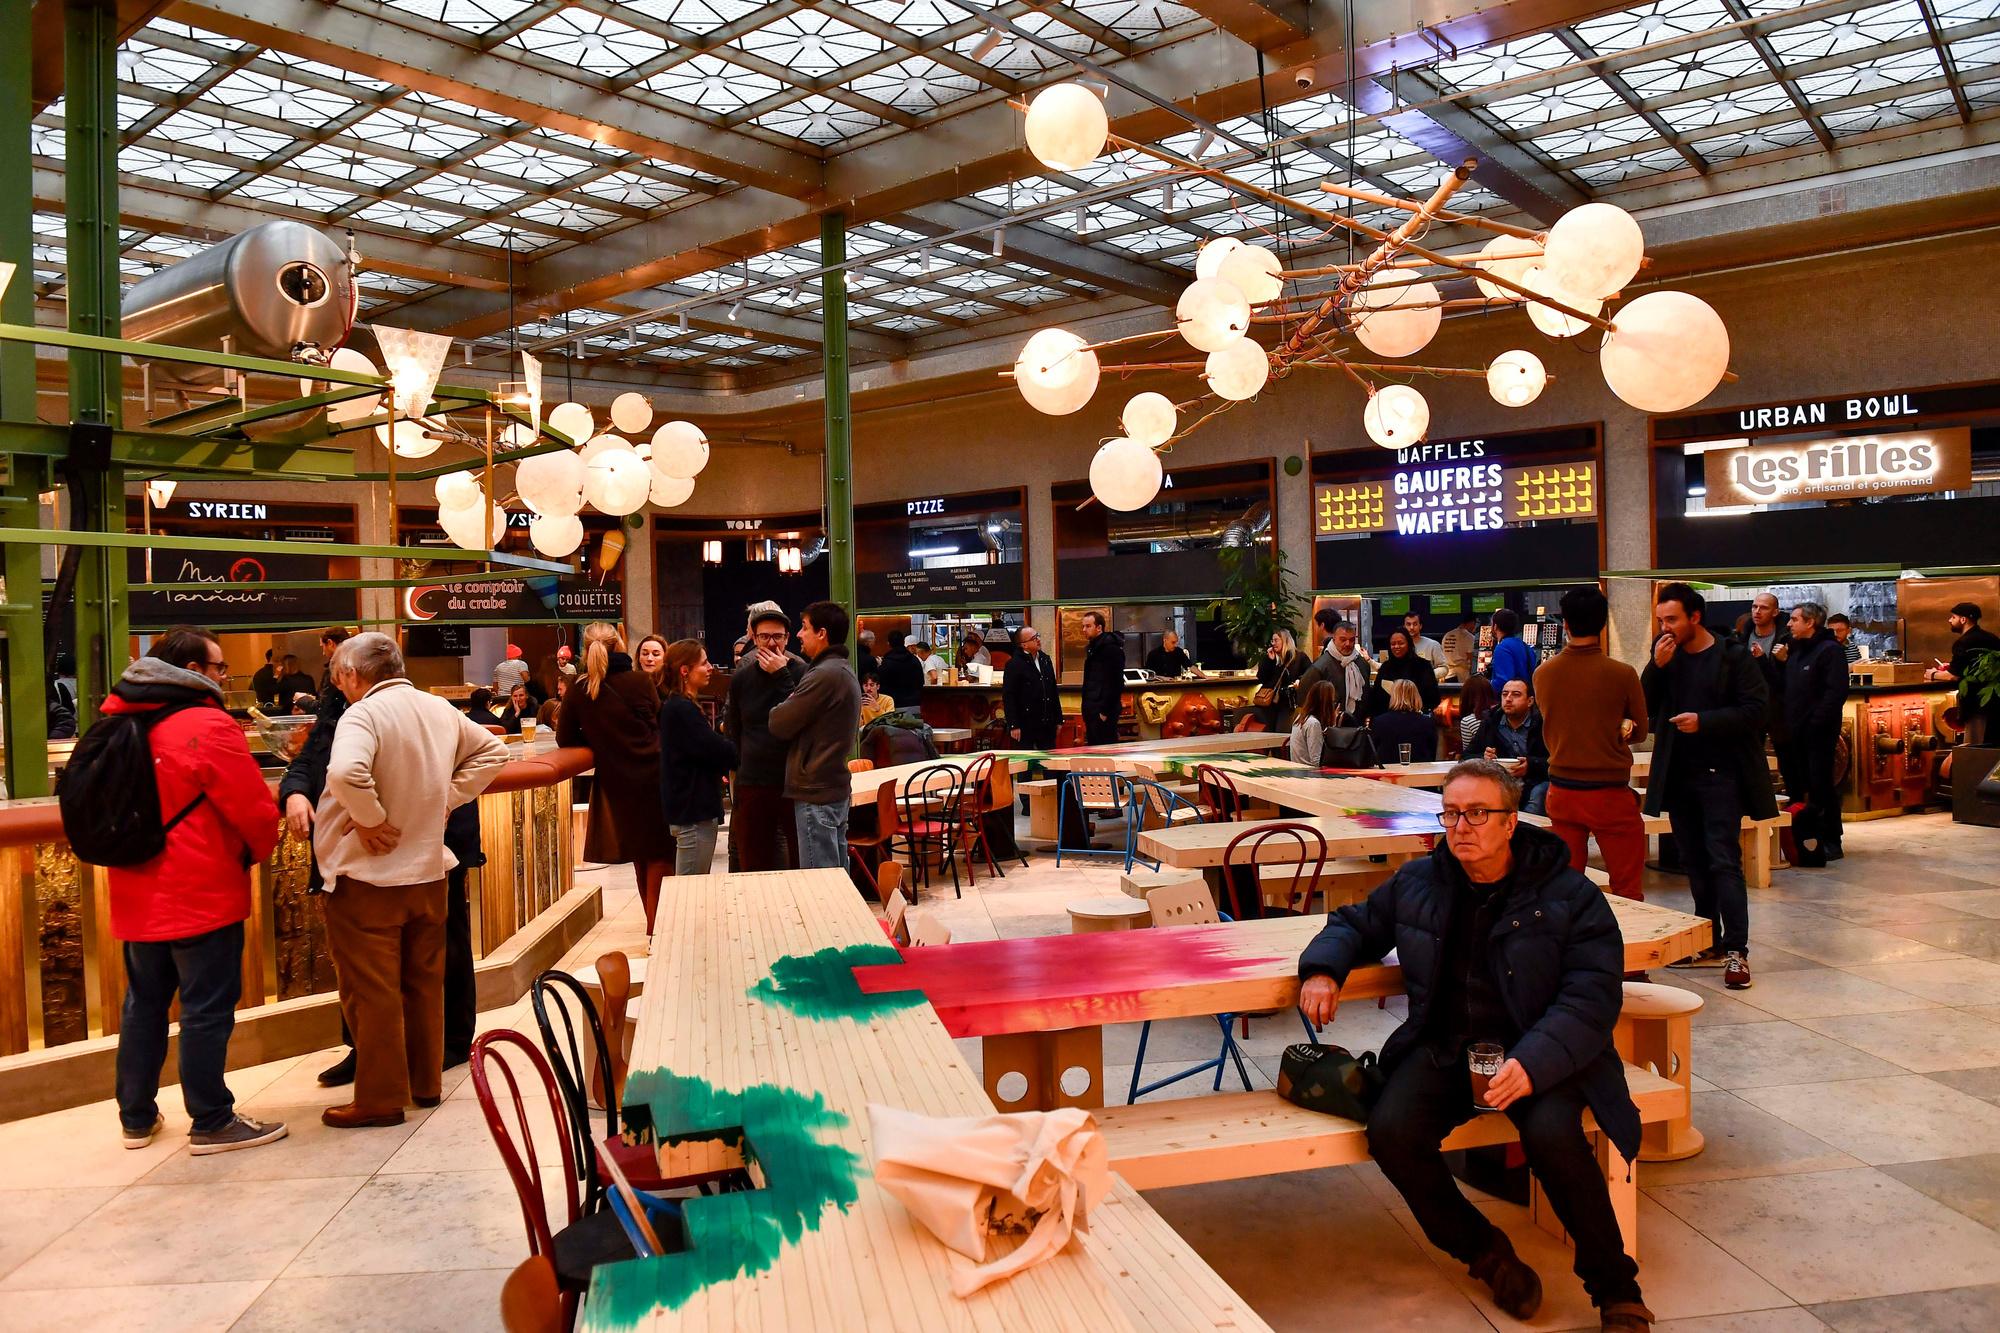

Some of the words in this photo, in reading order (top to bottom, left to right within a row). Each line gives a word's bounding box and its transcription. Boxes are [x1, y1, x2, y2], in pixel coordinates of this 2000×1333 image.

[1740, 403, 1826, 430] URBAN
[1846, 394, 1919, 420] BOWL
[1397, 440, 1485, 464] WAFFLES
[1735, 455, 1800, 496] Les
[1806, 443, 1933, 479] Filles
[1394, 463, 1503, 495] GAUFRES
[1804, 482, 1855, 494] artisanal
[1857, 481, 1868, 490] et
[1872, 475, 1933, 491] gourmand
[189, 502, 267, 520] SYRIEN
[907, 499, 945, 515] PIZZE
[726, 520, 763, 530] WOLF
[1395, 506, 1504, 536] WAFFLES
[465, 580, 524, 596] comptoir
[447, 596, 466, 609] du
[469, 596, 507, 609] crabe
[559, 593, 622, 606] COQUETTES
